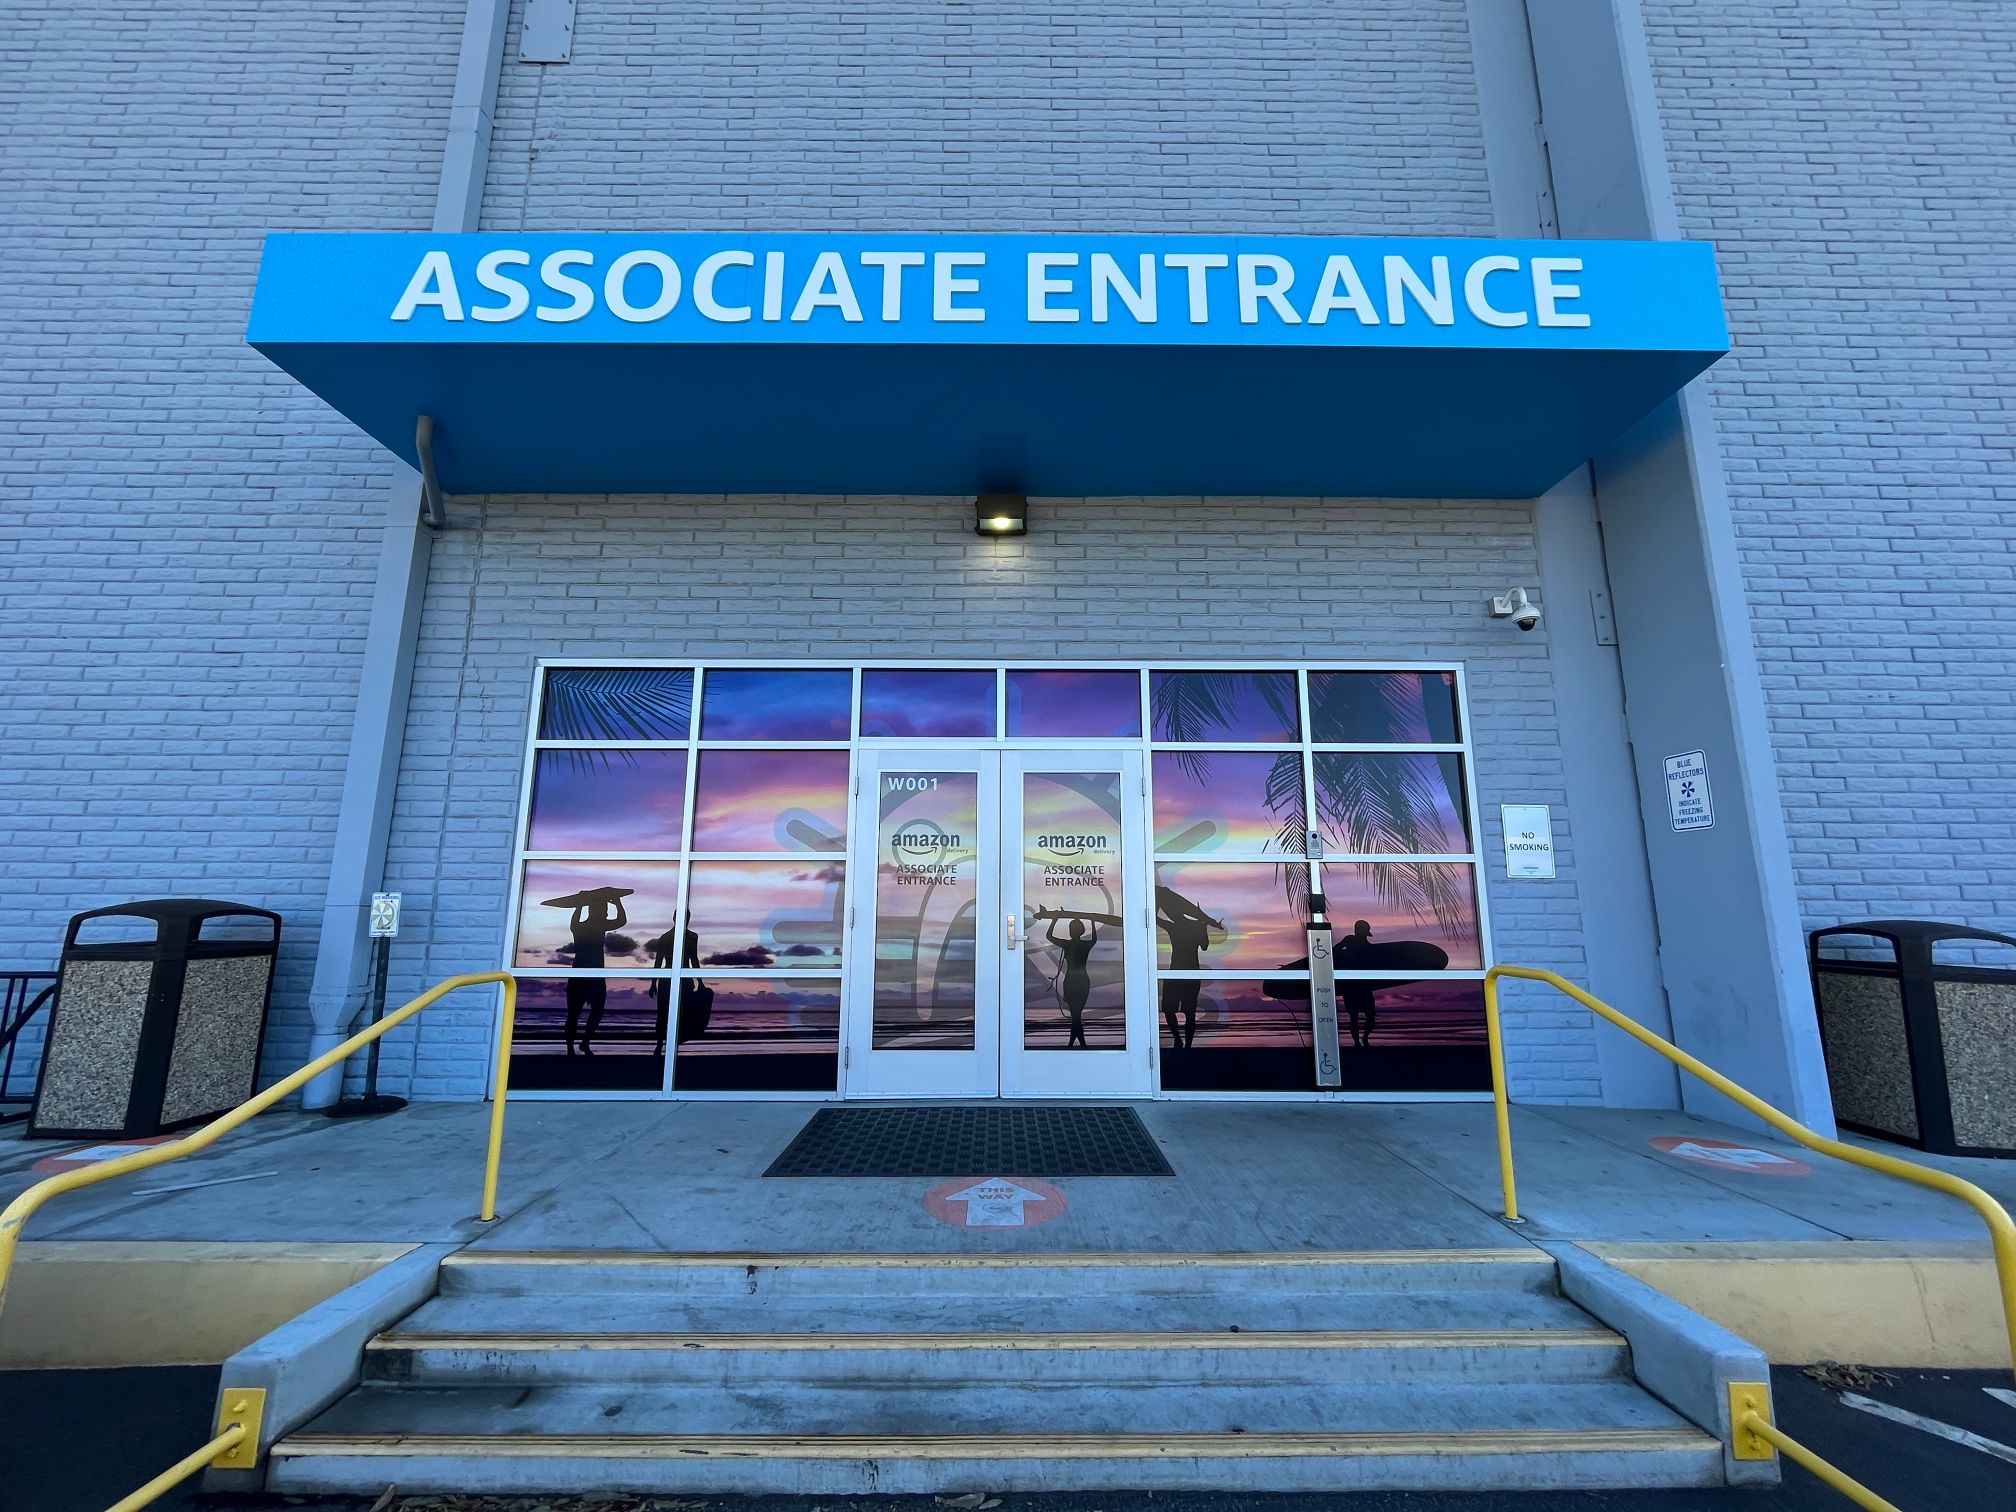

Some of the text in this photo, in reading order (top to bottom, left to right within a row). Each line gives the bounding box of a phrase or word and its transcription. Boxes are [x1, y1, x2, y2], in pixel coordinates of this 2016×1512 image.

[390, 249, 1592, 328] ASSOCIATE ENTRANCE
[1677, 759, 1691, 768] BLUE
[1668, 767, 1704, 780] REFLECTORS
[887, 777, 939, 791] W001
[1679, 798, 1702, 806] INDICATE
[1679, 807, 1704, 816] FREEZING
[1675, 815, 1711, 825] TEMPERATURE
[891, 833, 960, 847] amazon
[1521, 832, 1535, 840] NO
[1038, 835, 1107, 848] amazon
[1509, 843, 1549, 852] SMOKING
[896, 864, 958, 874] ASSOCIATE
[1043, 865, 1105, 875] ASSOCIATE
[897, 876, 957, 886] ENTRANCE
[1045, 877, 1105, 887] ENTRANCE
